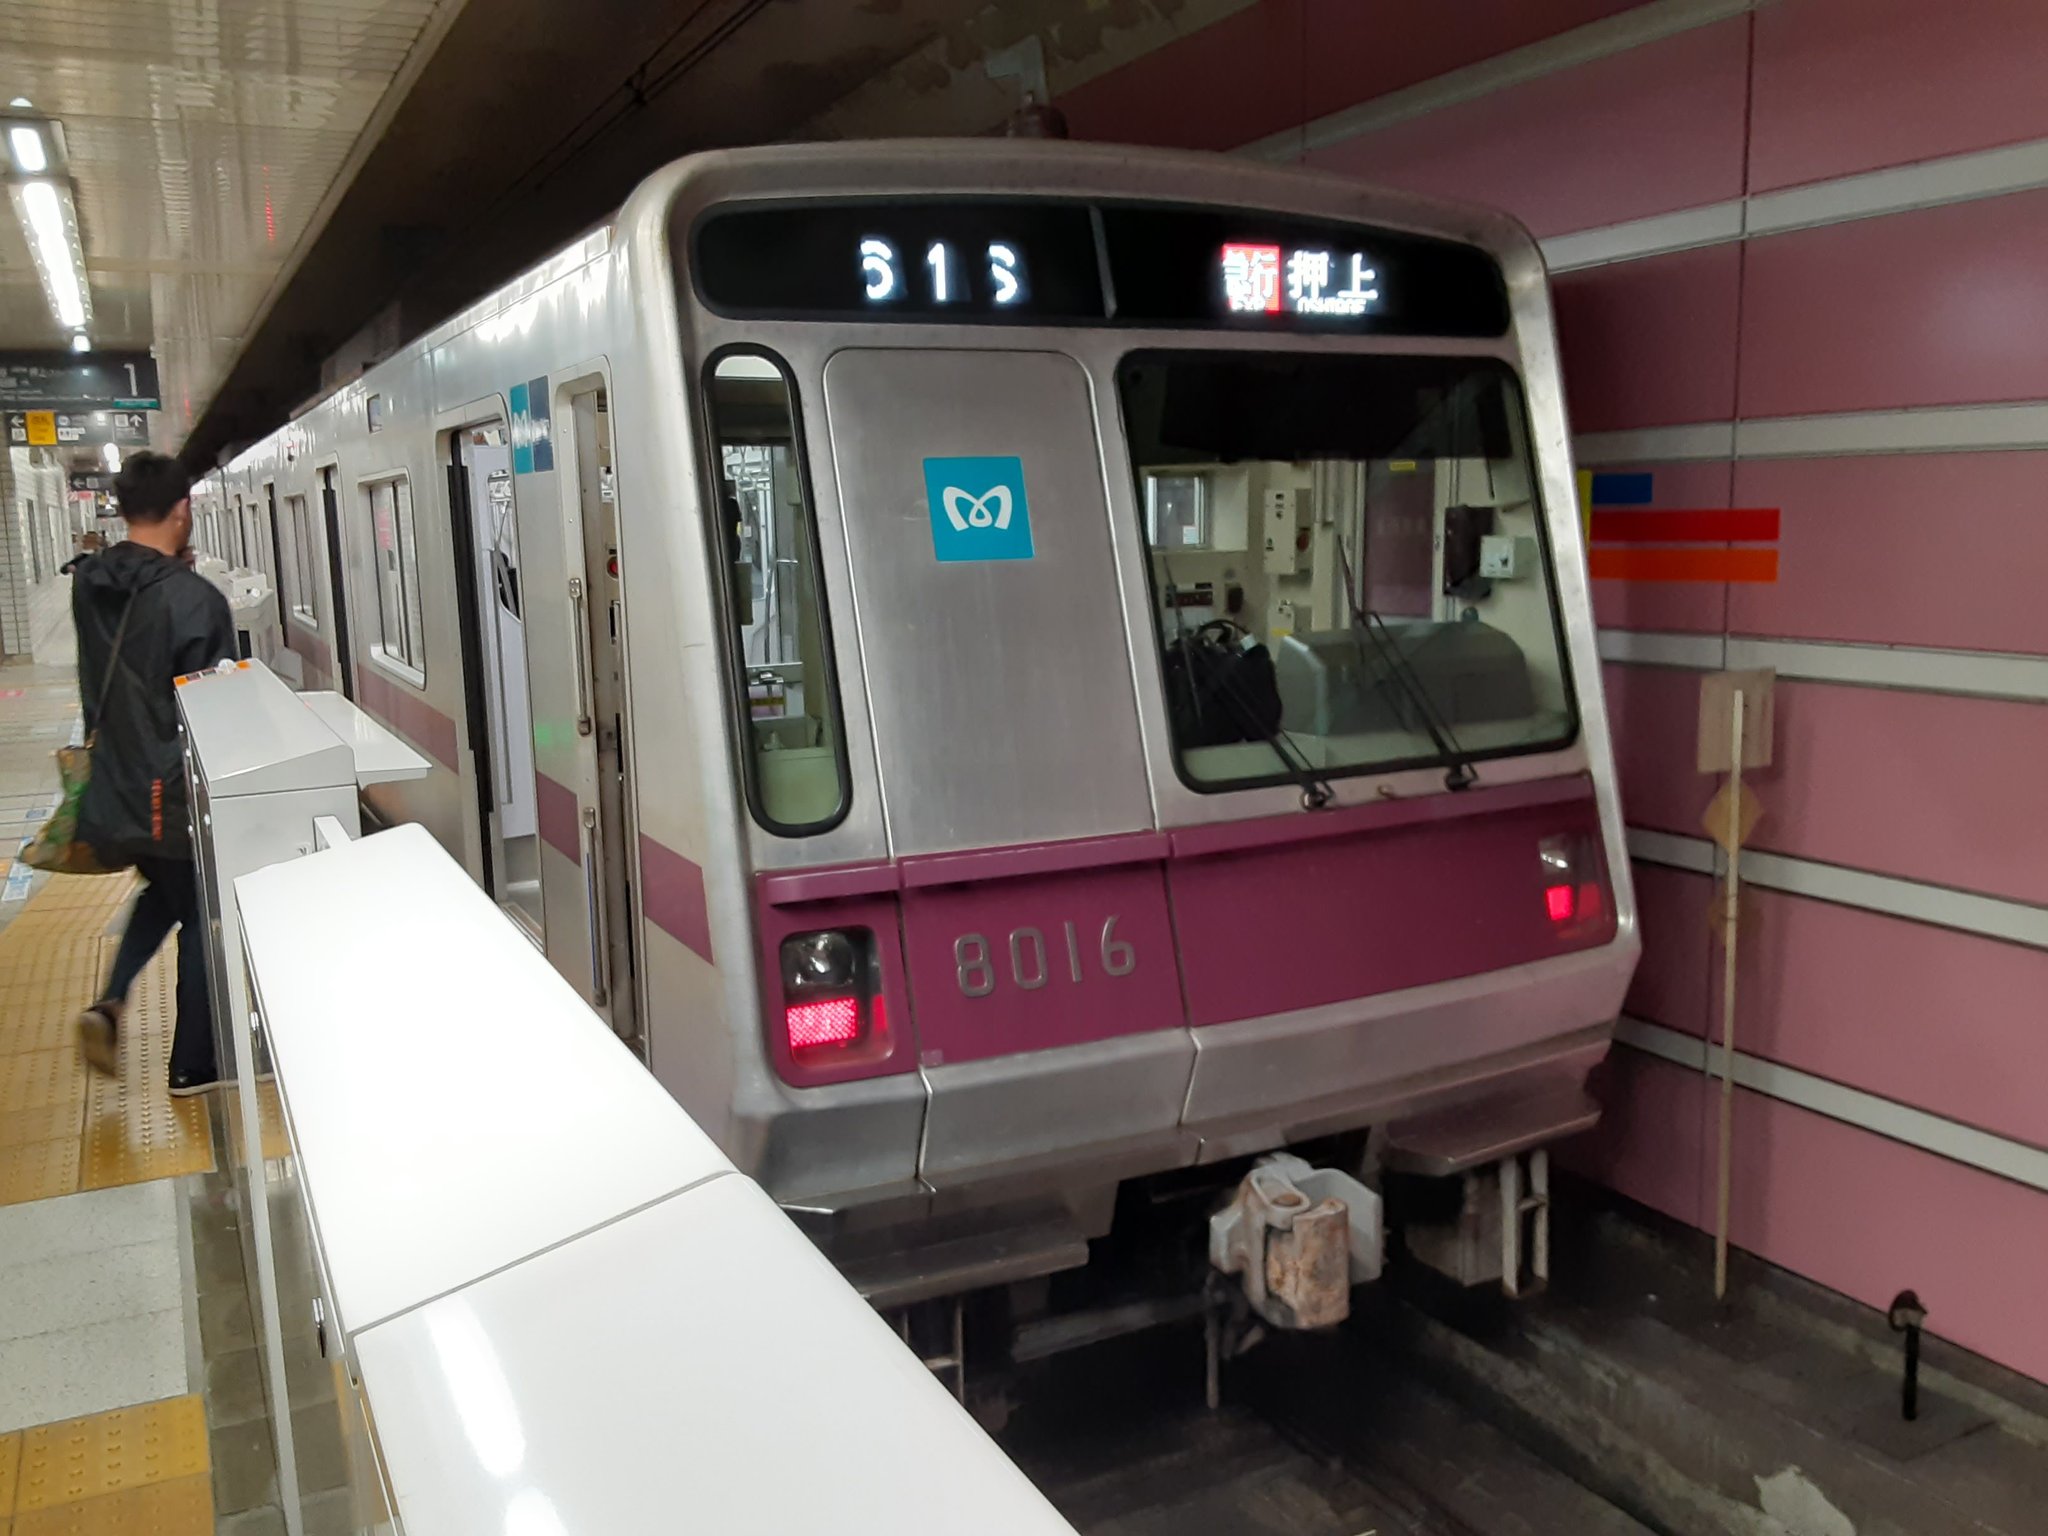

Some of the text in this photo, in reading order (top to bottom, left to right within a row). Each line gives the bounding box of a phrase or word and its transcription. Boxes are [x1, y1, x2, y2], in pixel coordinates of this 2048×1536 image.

[1287, 250, 1378, 300] 押上
[123, 363, 138, 397] 1
[954, 914, 1136, 998] 8016
